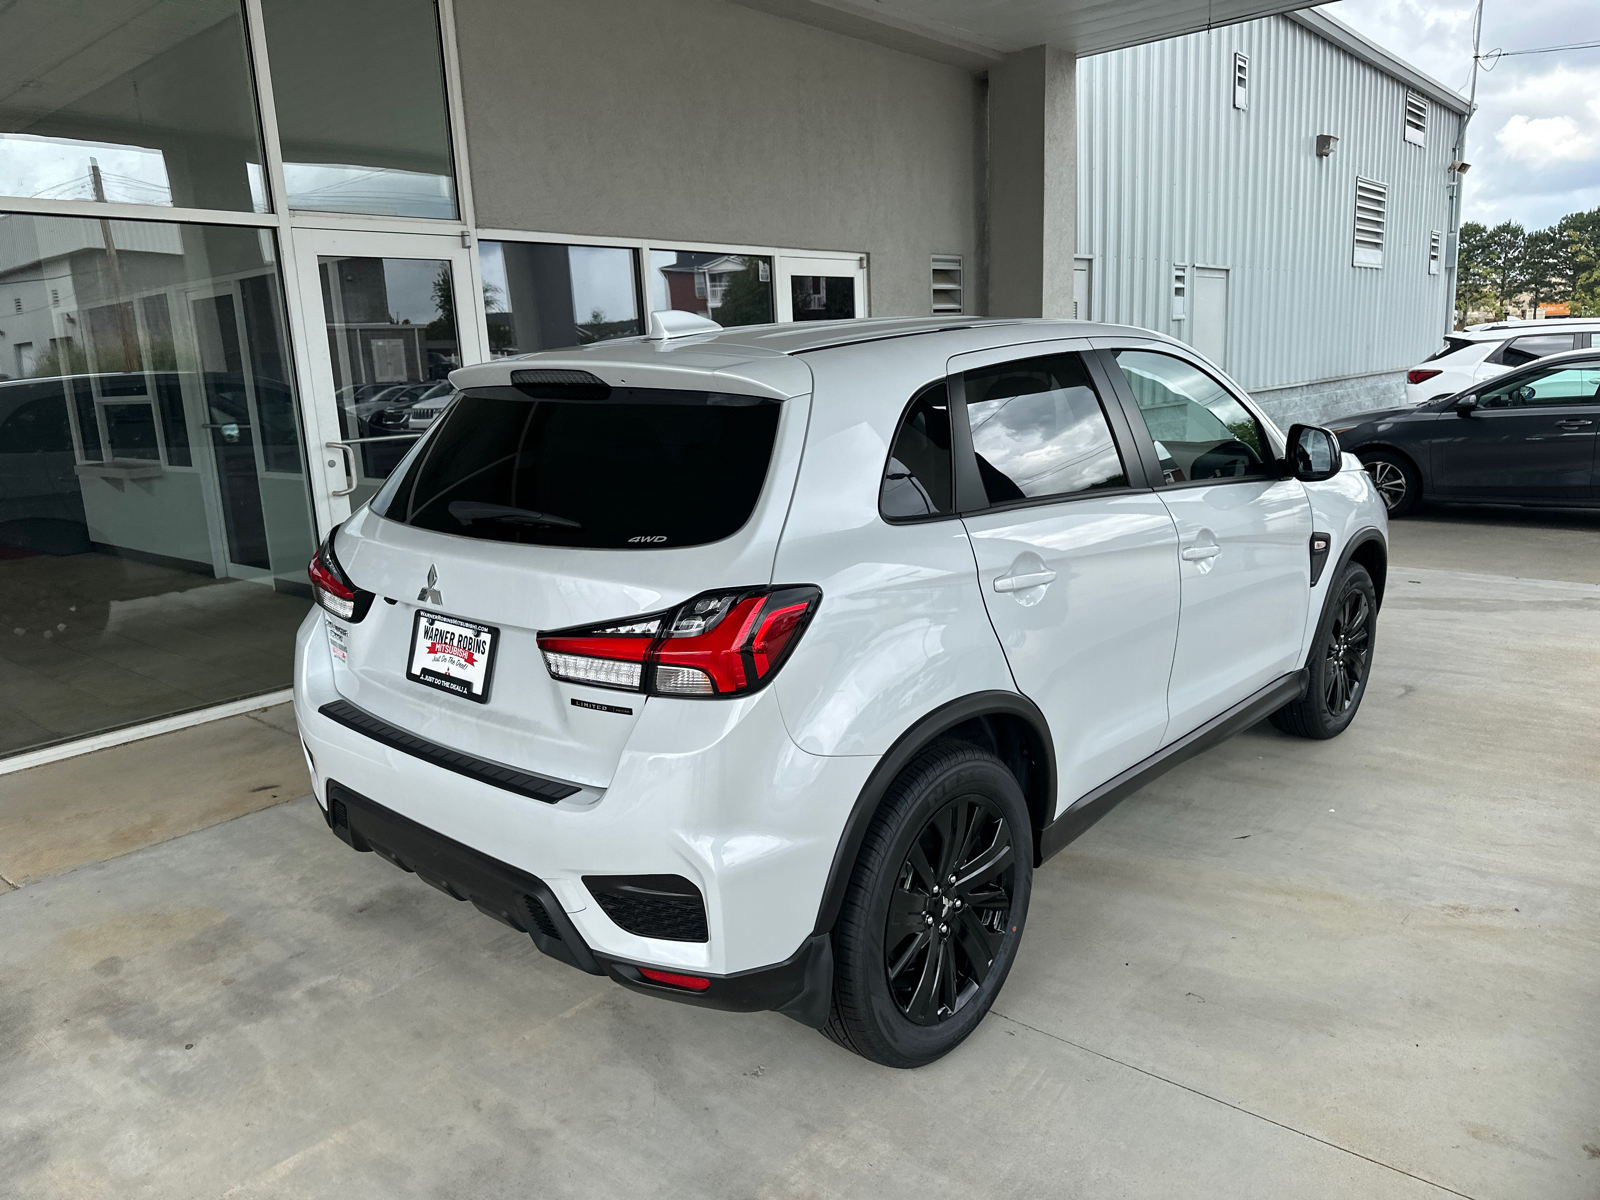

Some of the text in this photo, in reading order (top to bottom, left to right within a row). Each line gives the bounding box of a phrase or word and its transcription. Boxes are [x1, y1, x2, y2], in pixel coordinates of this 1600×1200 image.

[423, 625, 487, 655] WARNER ROBINS
[435, 643, 469, 660] MITSUBISHI
[423, 675, 435, 683] JUST
[434, 678, 442, 686] DO
[441, 680, 450, 689] THE
[576, 701, 608, 711] LIMITED
